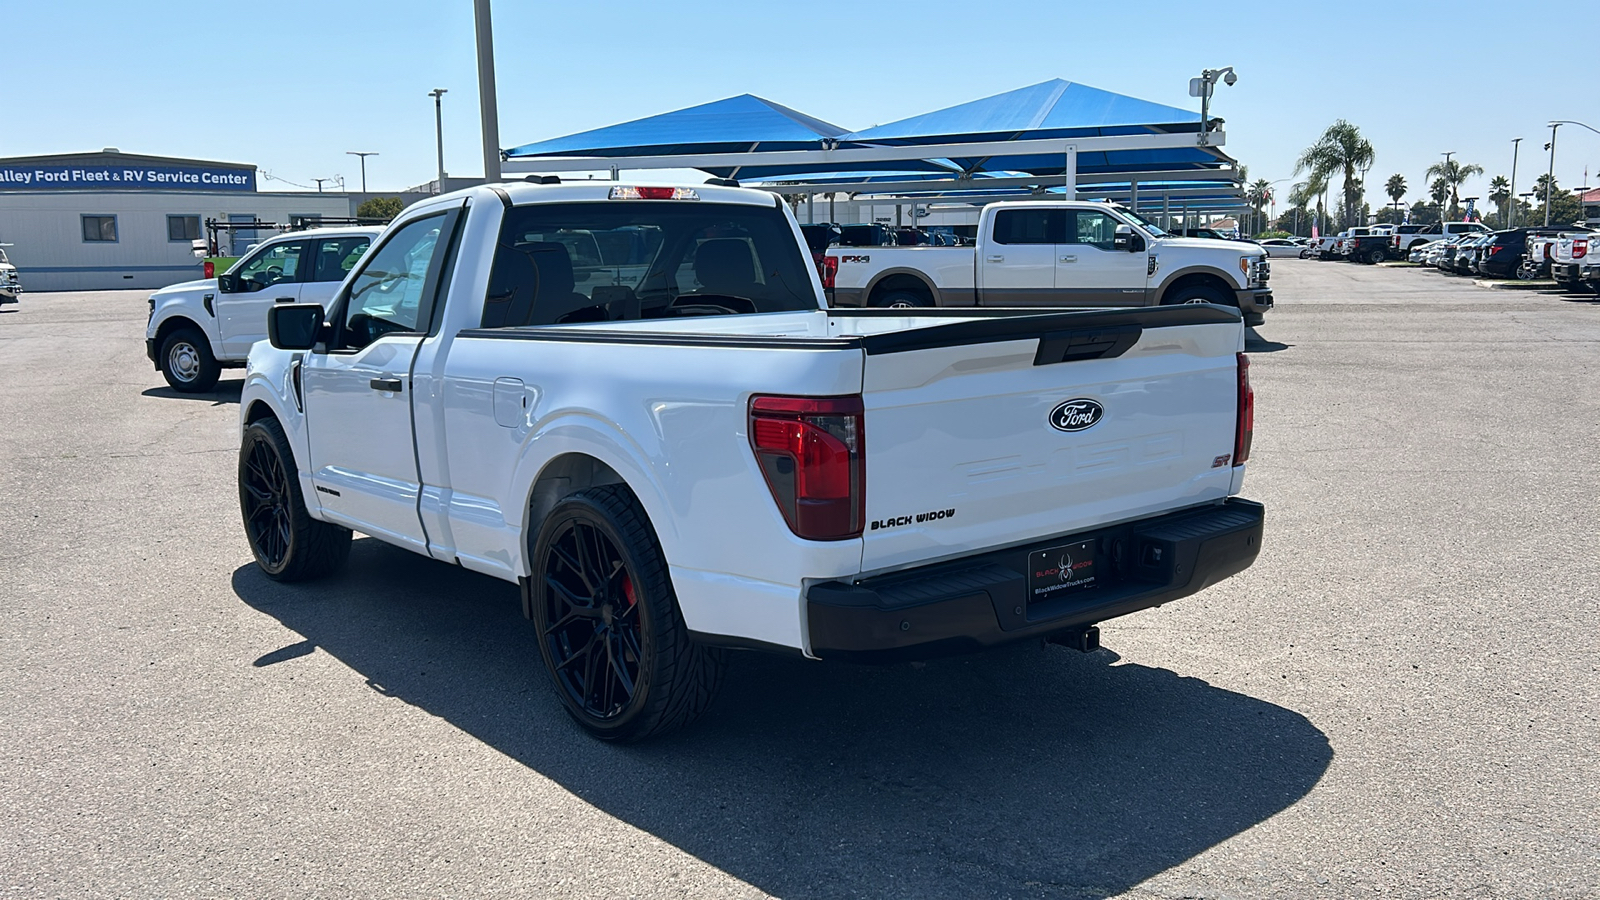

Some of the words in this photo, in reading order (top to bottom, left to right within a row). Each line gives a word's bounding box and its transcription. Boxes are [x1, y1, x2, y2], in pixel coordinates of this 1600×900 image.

[35, 170, 69, 181] Ford
[72, 170, 109, 181] Fleet
[123, 170, 144, 181] RV
[147, 171, 199, 183] Service
[201, 172, 247, 184] Center
[841, 255, 870, 263] FX4
[1060, 404, 1095, 427] Ford
[871, 515, 913, 530] BLACK
[916, 508, 955, 523] WIDOW
[1036, 568, 1059, 578] BLACK
[1072, 560, 1093, 570] WIDOW
[1034, 576, 1095, 595] BlackWidowTrucks.com
